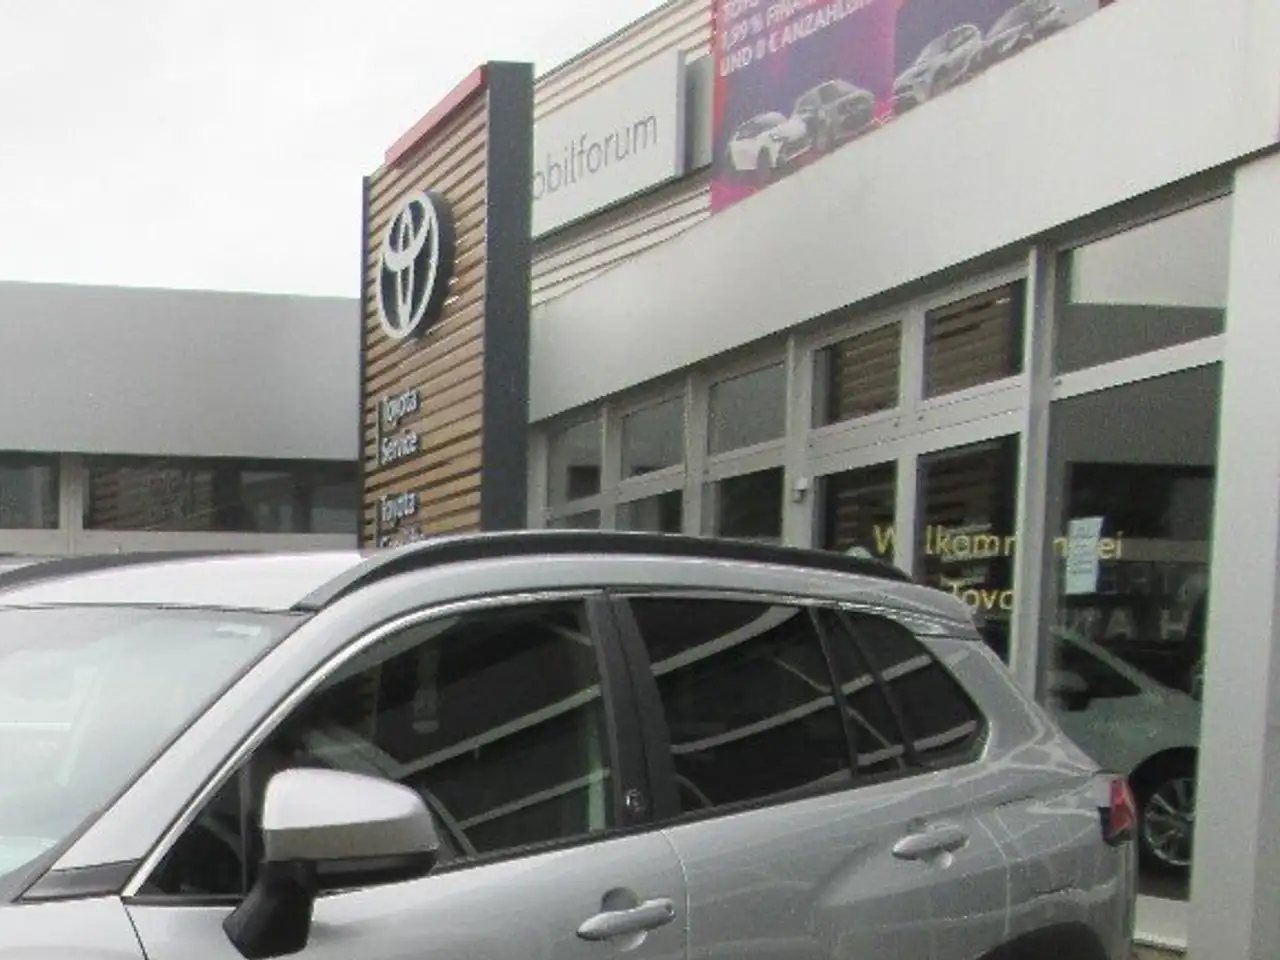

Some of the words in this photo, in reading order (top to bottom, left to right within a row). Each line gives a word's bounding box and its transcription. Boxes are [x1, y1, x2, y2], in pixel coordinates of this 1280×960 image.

[720, 46, 753, 77] UND
[382, 389, 418, 427] Toyota
[381, 431, 419, 467] Service
[379, 492, 417, 523] Toyota
